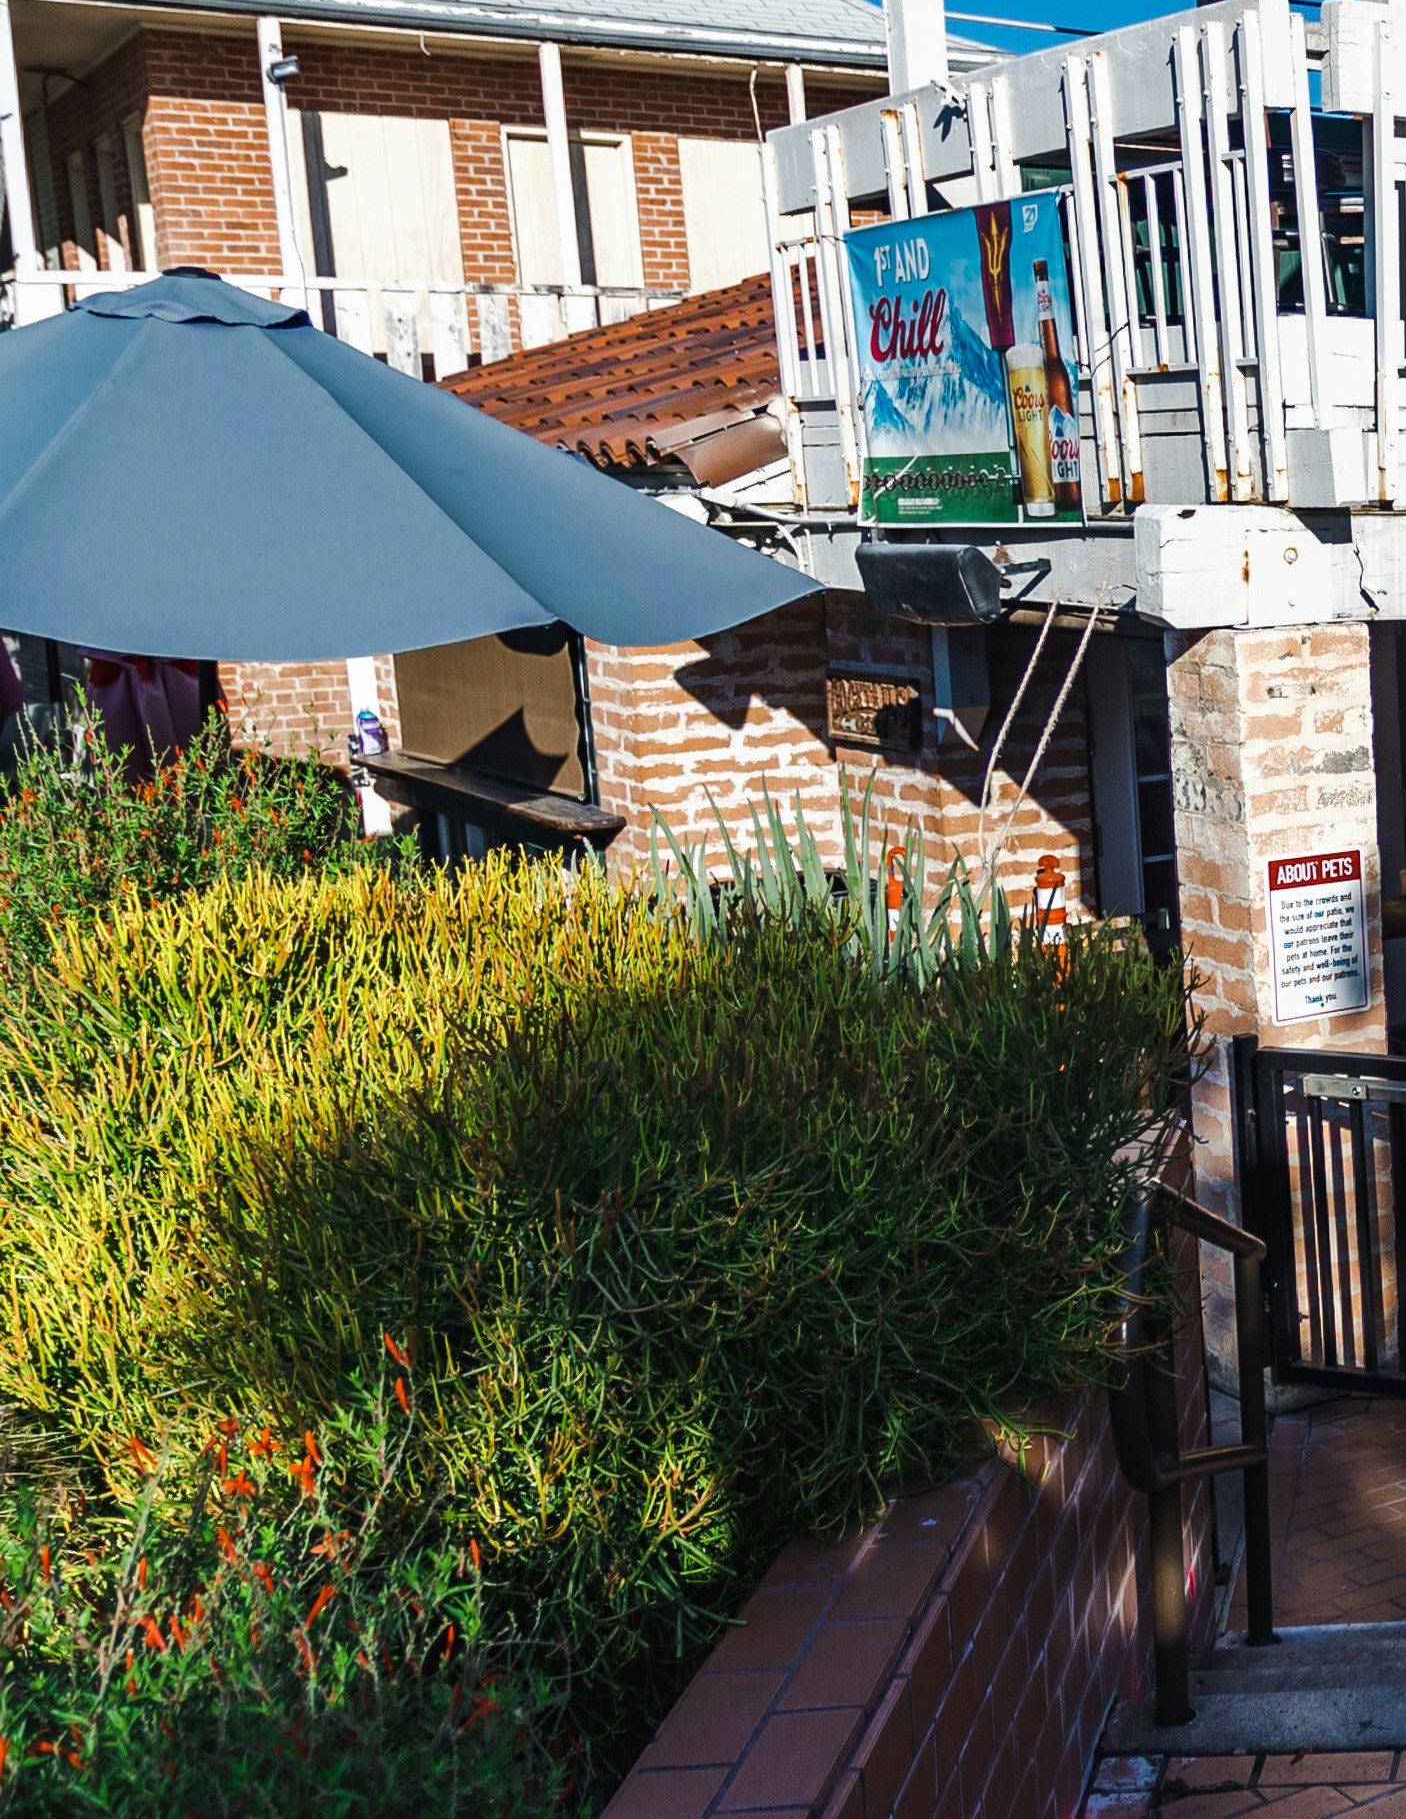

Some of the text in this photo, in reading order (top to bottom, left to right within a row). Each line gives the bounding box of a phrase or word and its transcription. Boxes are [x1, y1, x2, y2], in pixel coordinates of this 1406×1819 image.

[873, 237, 930, 288] 1ST AND
[867, 287, 947, 363] Chill
[1012, 386, 1045, 411] Coors
[1018, 409, 1043, 423] LIGHT
[1049, 429, 1080, 460] oors
[1053, 460, 1079, 478] IGHT
[1277, 858, 1353, 884] ABOUT PETS
[1281, 892, 1352, 910] Due to the crowds and
[1280, 914, 1289, 923] the
[1292, 912, 1304, 922] size
[1306, 910, 1313, 919] of
[1314, 910, 1324, 918] our
[1345, 906, 1354, 914] we
[1284, 918, 1352, 936] would appreciate that
[1283, 930, 1354, 949] our patrons leave their
[1287, 944, 1352, 963] pets at home. For the
[1282, 954, 1358, 976] safety and well-being of
[1281, 968, 1359, 989] our pets and our patrons.
[1305, 993, 1324, 1004] Thank
